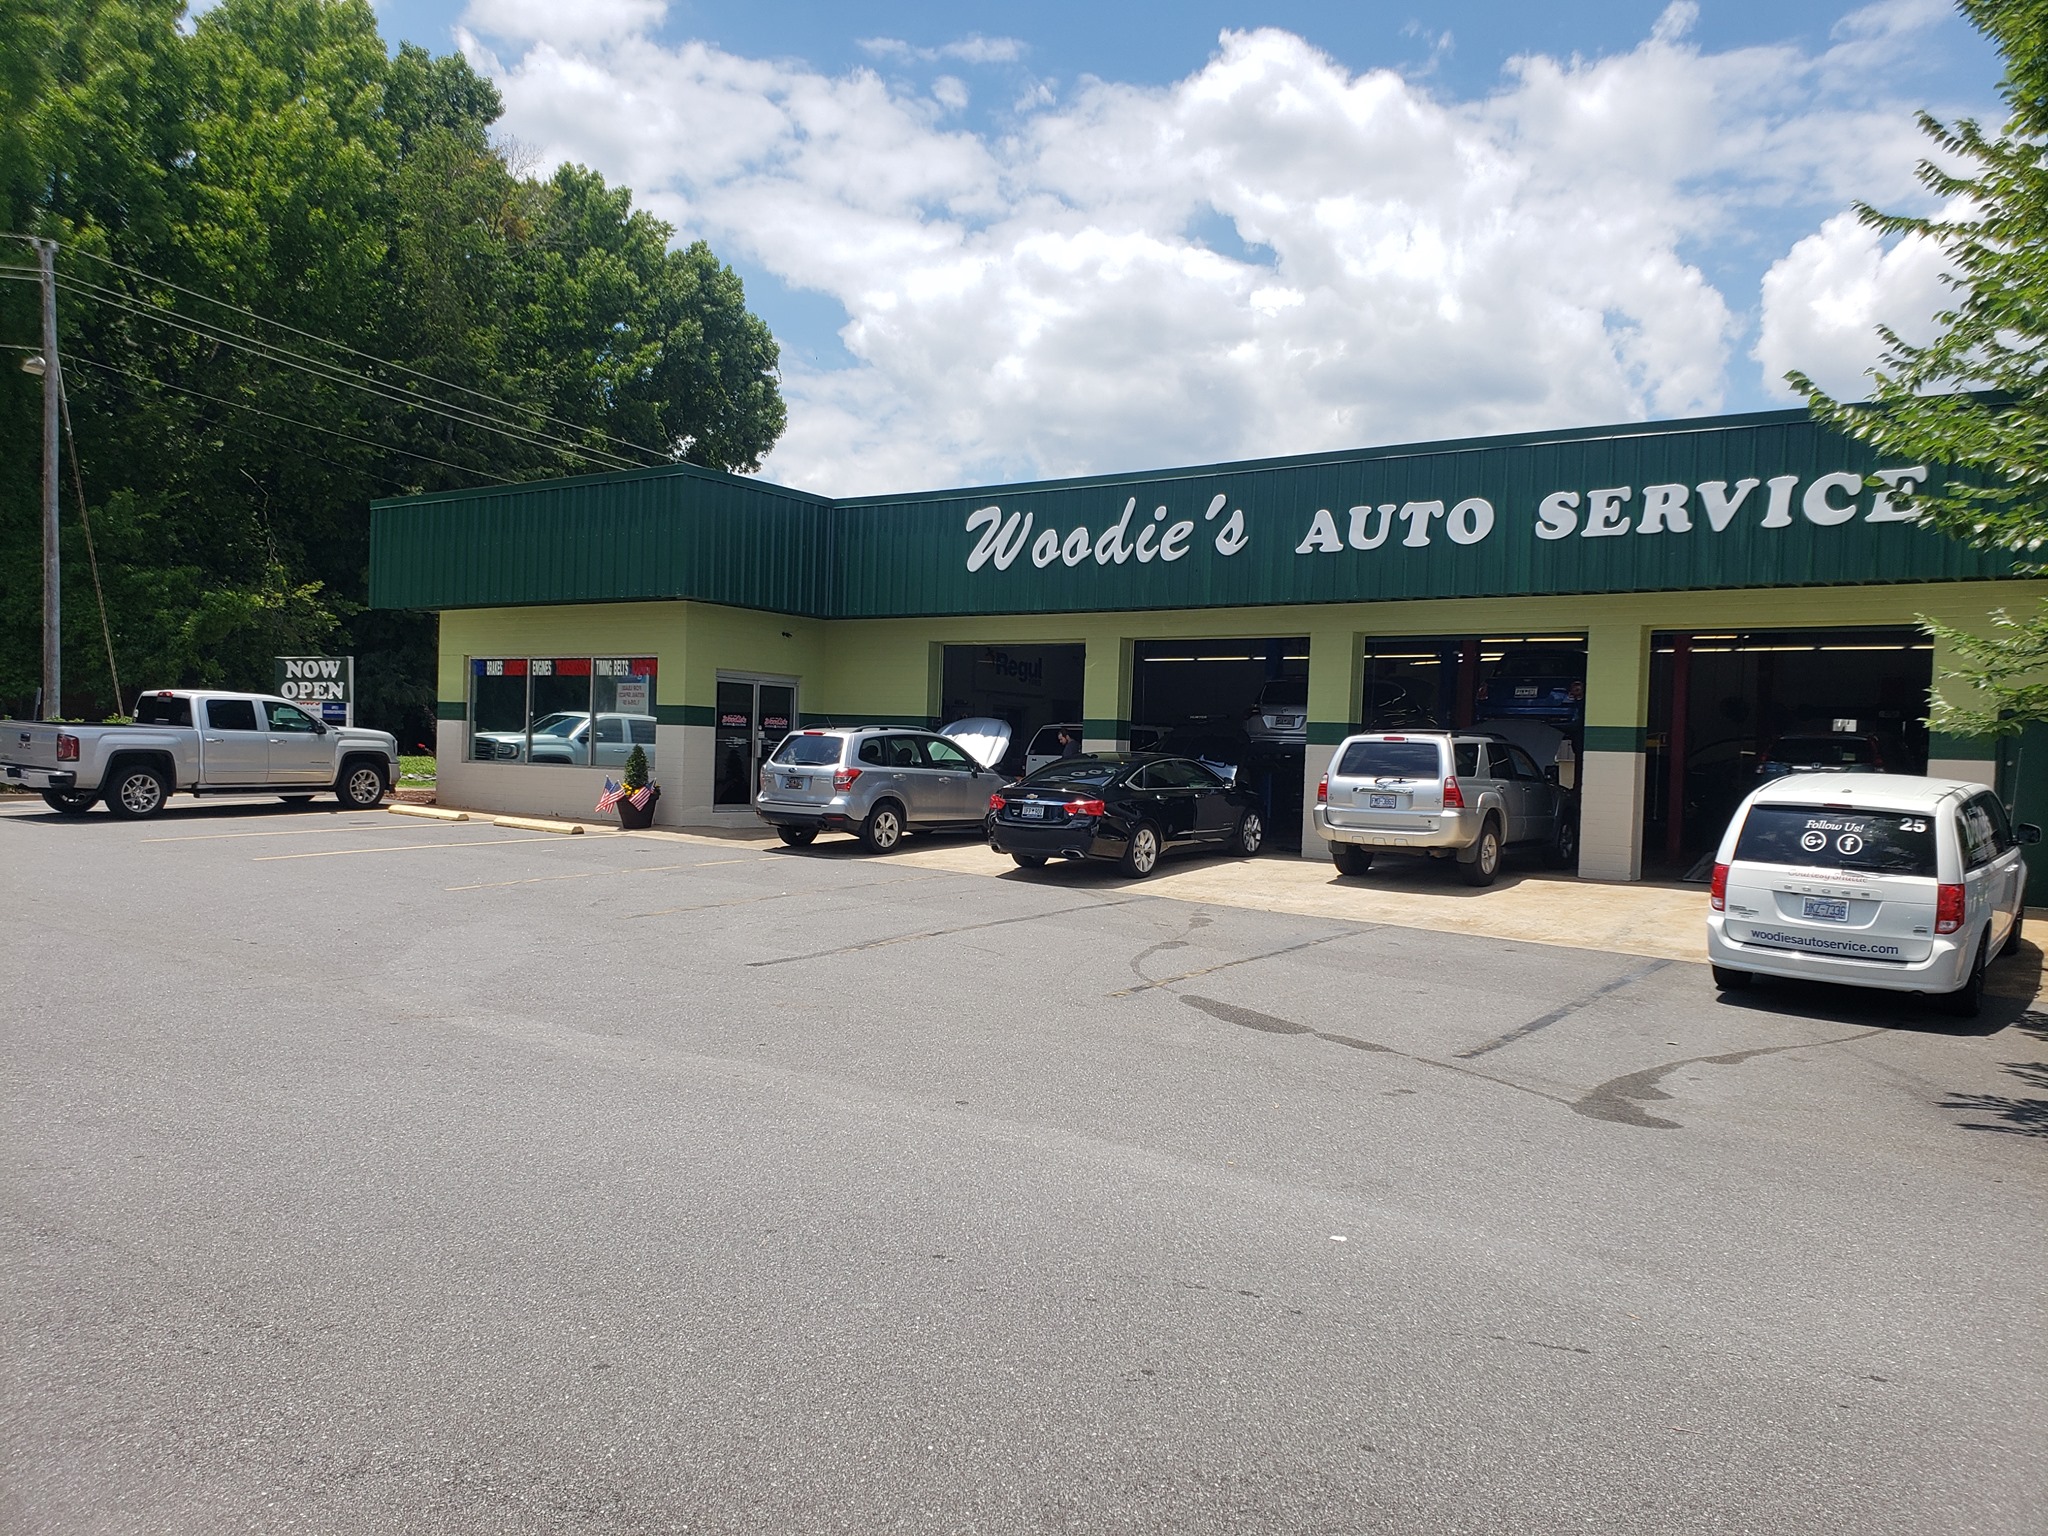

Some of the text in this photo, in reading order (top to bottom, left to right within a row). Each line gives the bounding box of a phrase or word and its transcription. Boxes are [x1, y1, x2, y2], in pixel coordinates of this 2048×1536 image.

[966, 465, 1928, 573] Woodie's AUTO SERVICE
[285, 660, 341, 679] NOW
[486, 660, 503, 676] BRAKES
[532, 660, 552, 676] ENGINES
[596, 660, 613, 676] TIMING
[613, 660, 629, 676] BELTS
[281, 681, 345, 700] OPEN
[1804, 820, 1865, 833] Follow Us!
[1899, 818, 1927, 833] 25
[1751, 929, 1899, 955] woodiesautoservice.com
